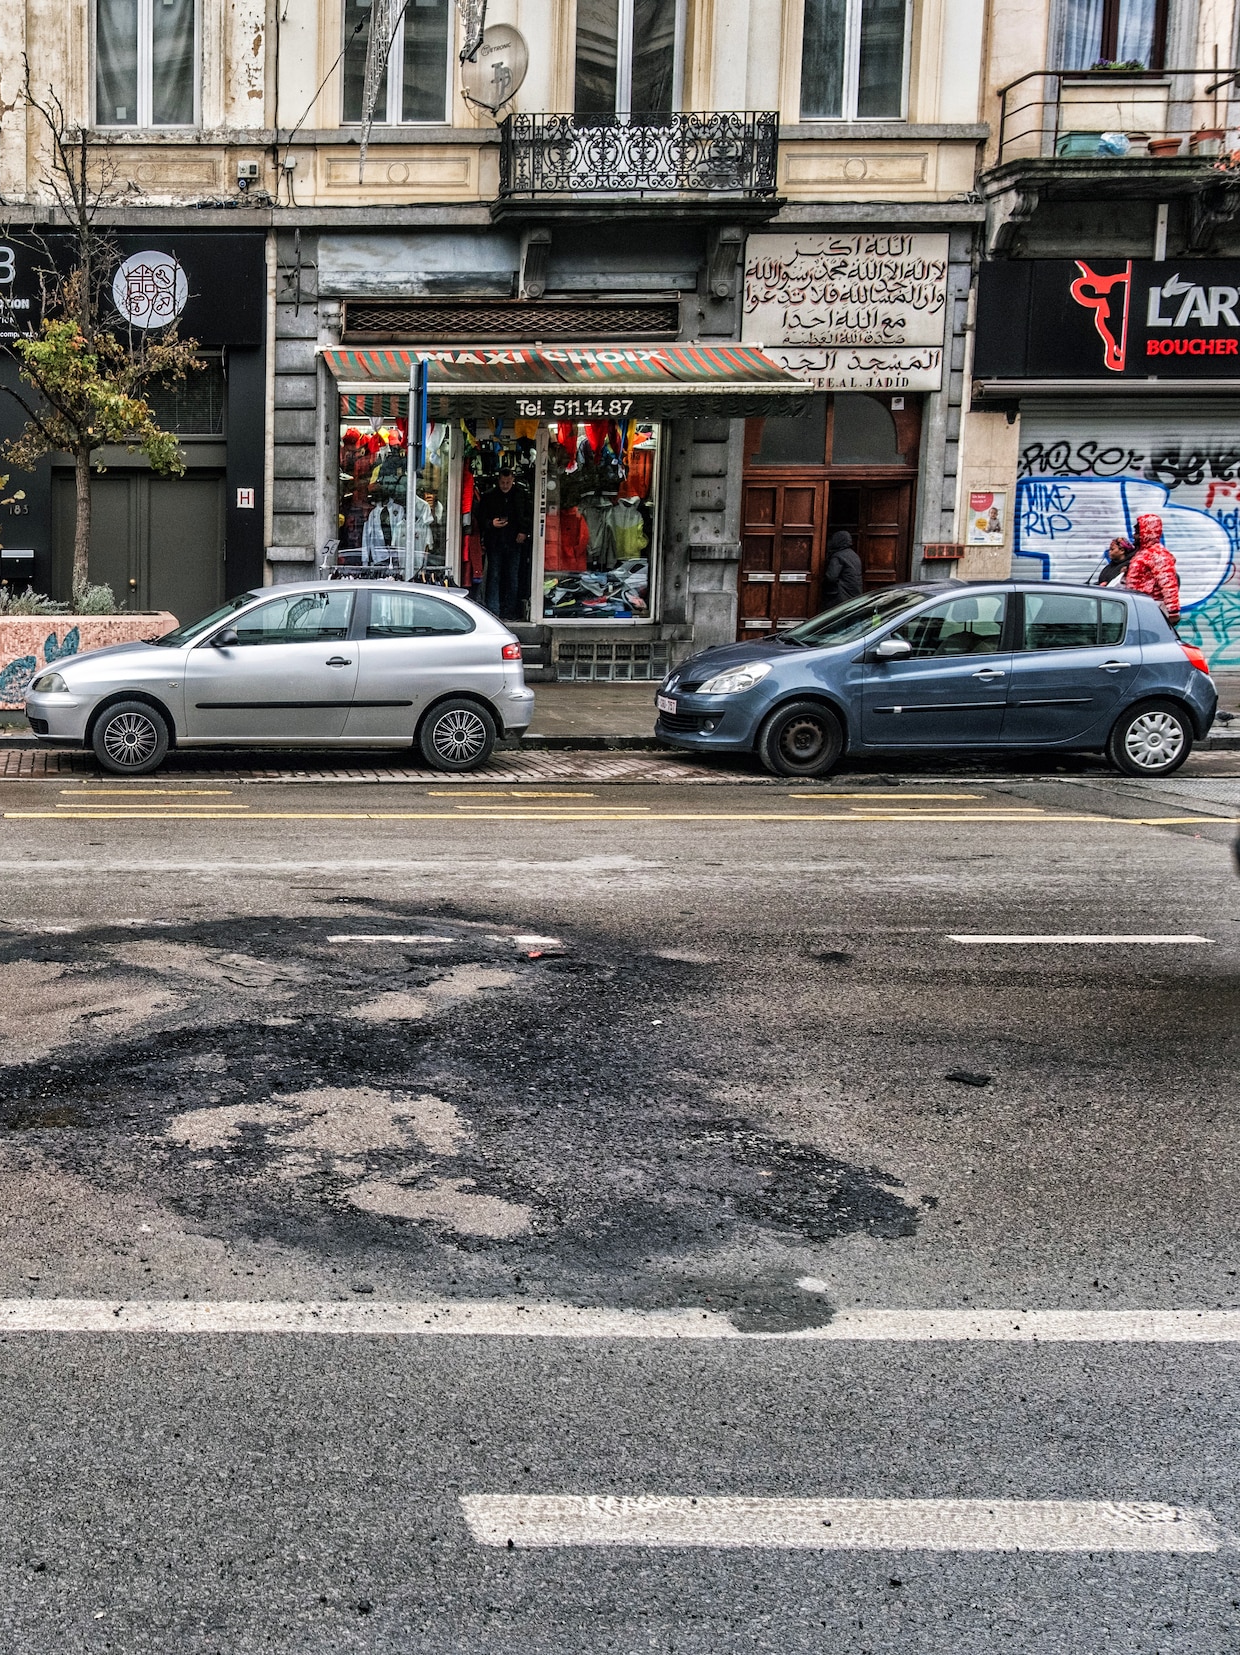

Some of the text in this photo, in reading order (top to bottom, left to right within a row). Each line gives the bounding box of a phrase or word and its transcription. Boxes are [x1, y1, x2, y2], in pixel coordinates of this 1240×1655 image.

[417, 352, 525, 365] MAXI
[516, 400, 633, 416] Tel. 511.14.87
[240, 491, 250, 505] H
[9, 504, 29, 515] 183
